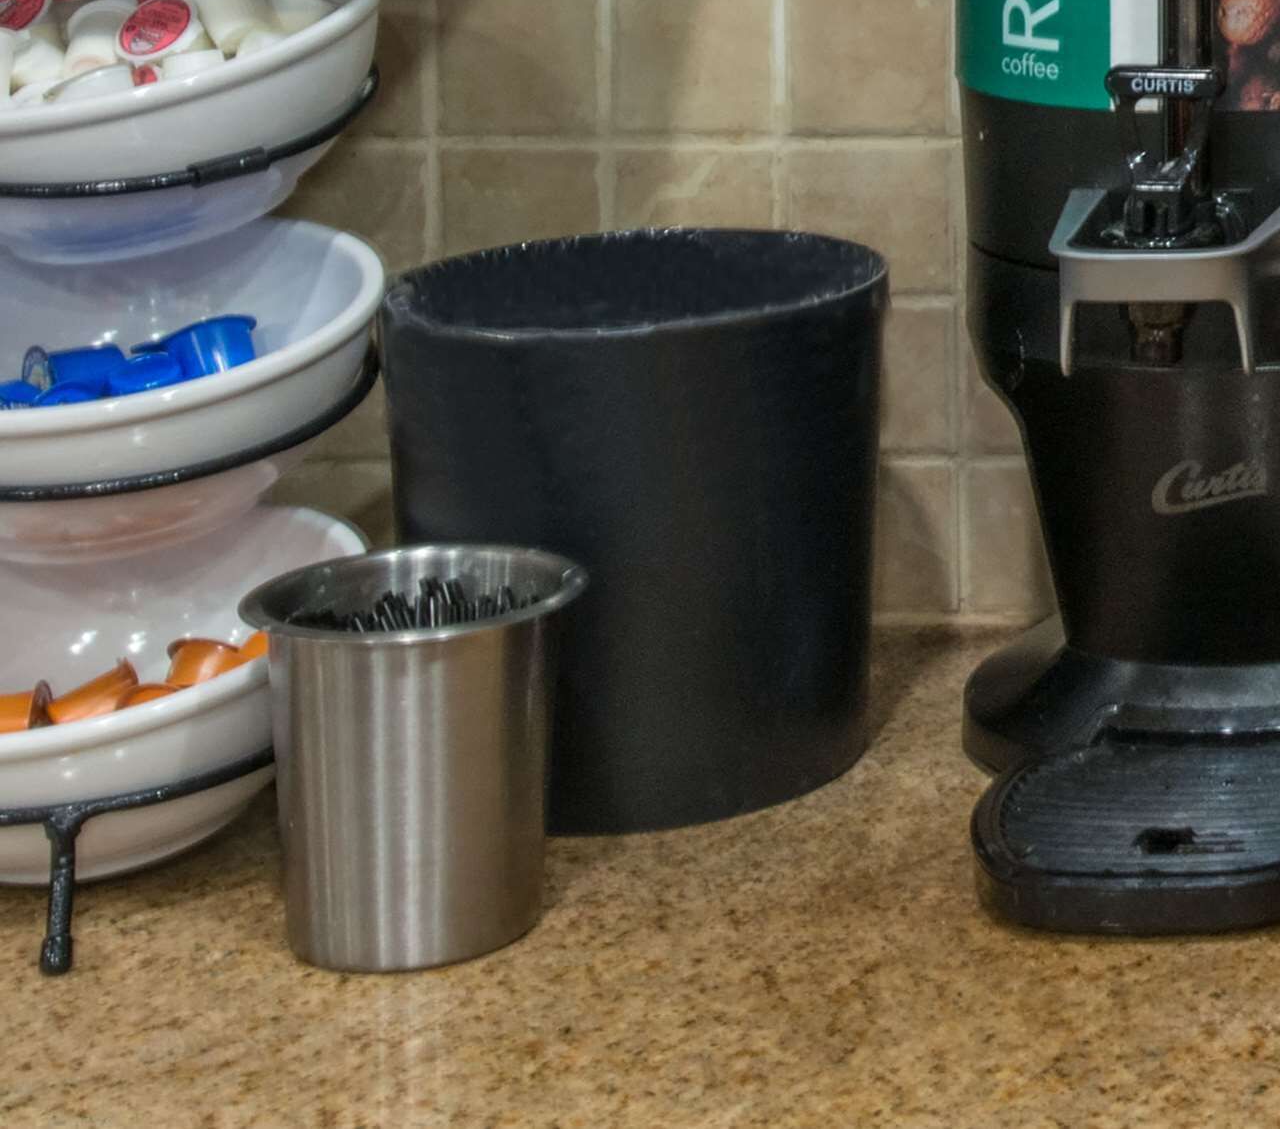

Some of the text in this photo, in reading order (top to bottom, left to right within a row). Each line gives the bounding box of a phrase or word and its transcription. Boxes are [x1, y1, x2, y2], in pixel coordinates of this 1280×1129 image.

[1002, 52, 1059, 80] coffee
[1131, 77, 1195, 94] CURTIS
[1151, 458, 1268, 514] Curtis
